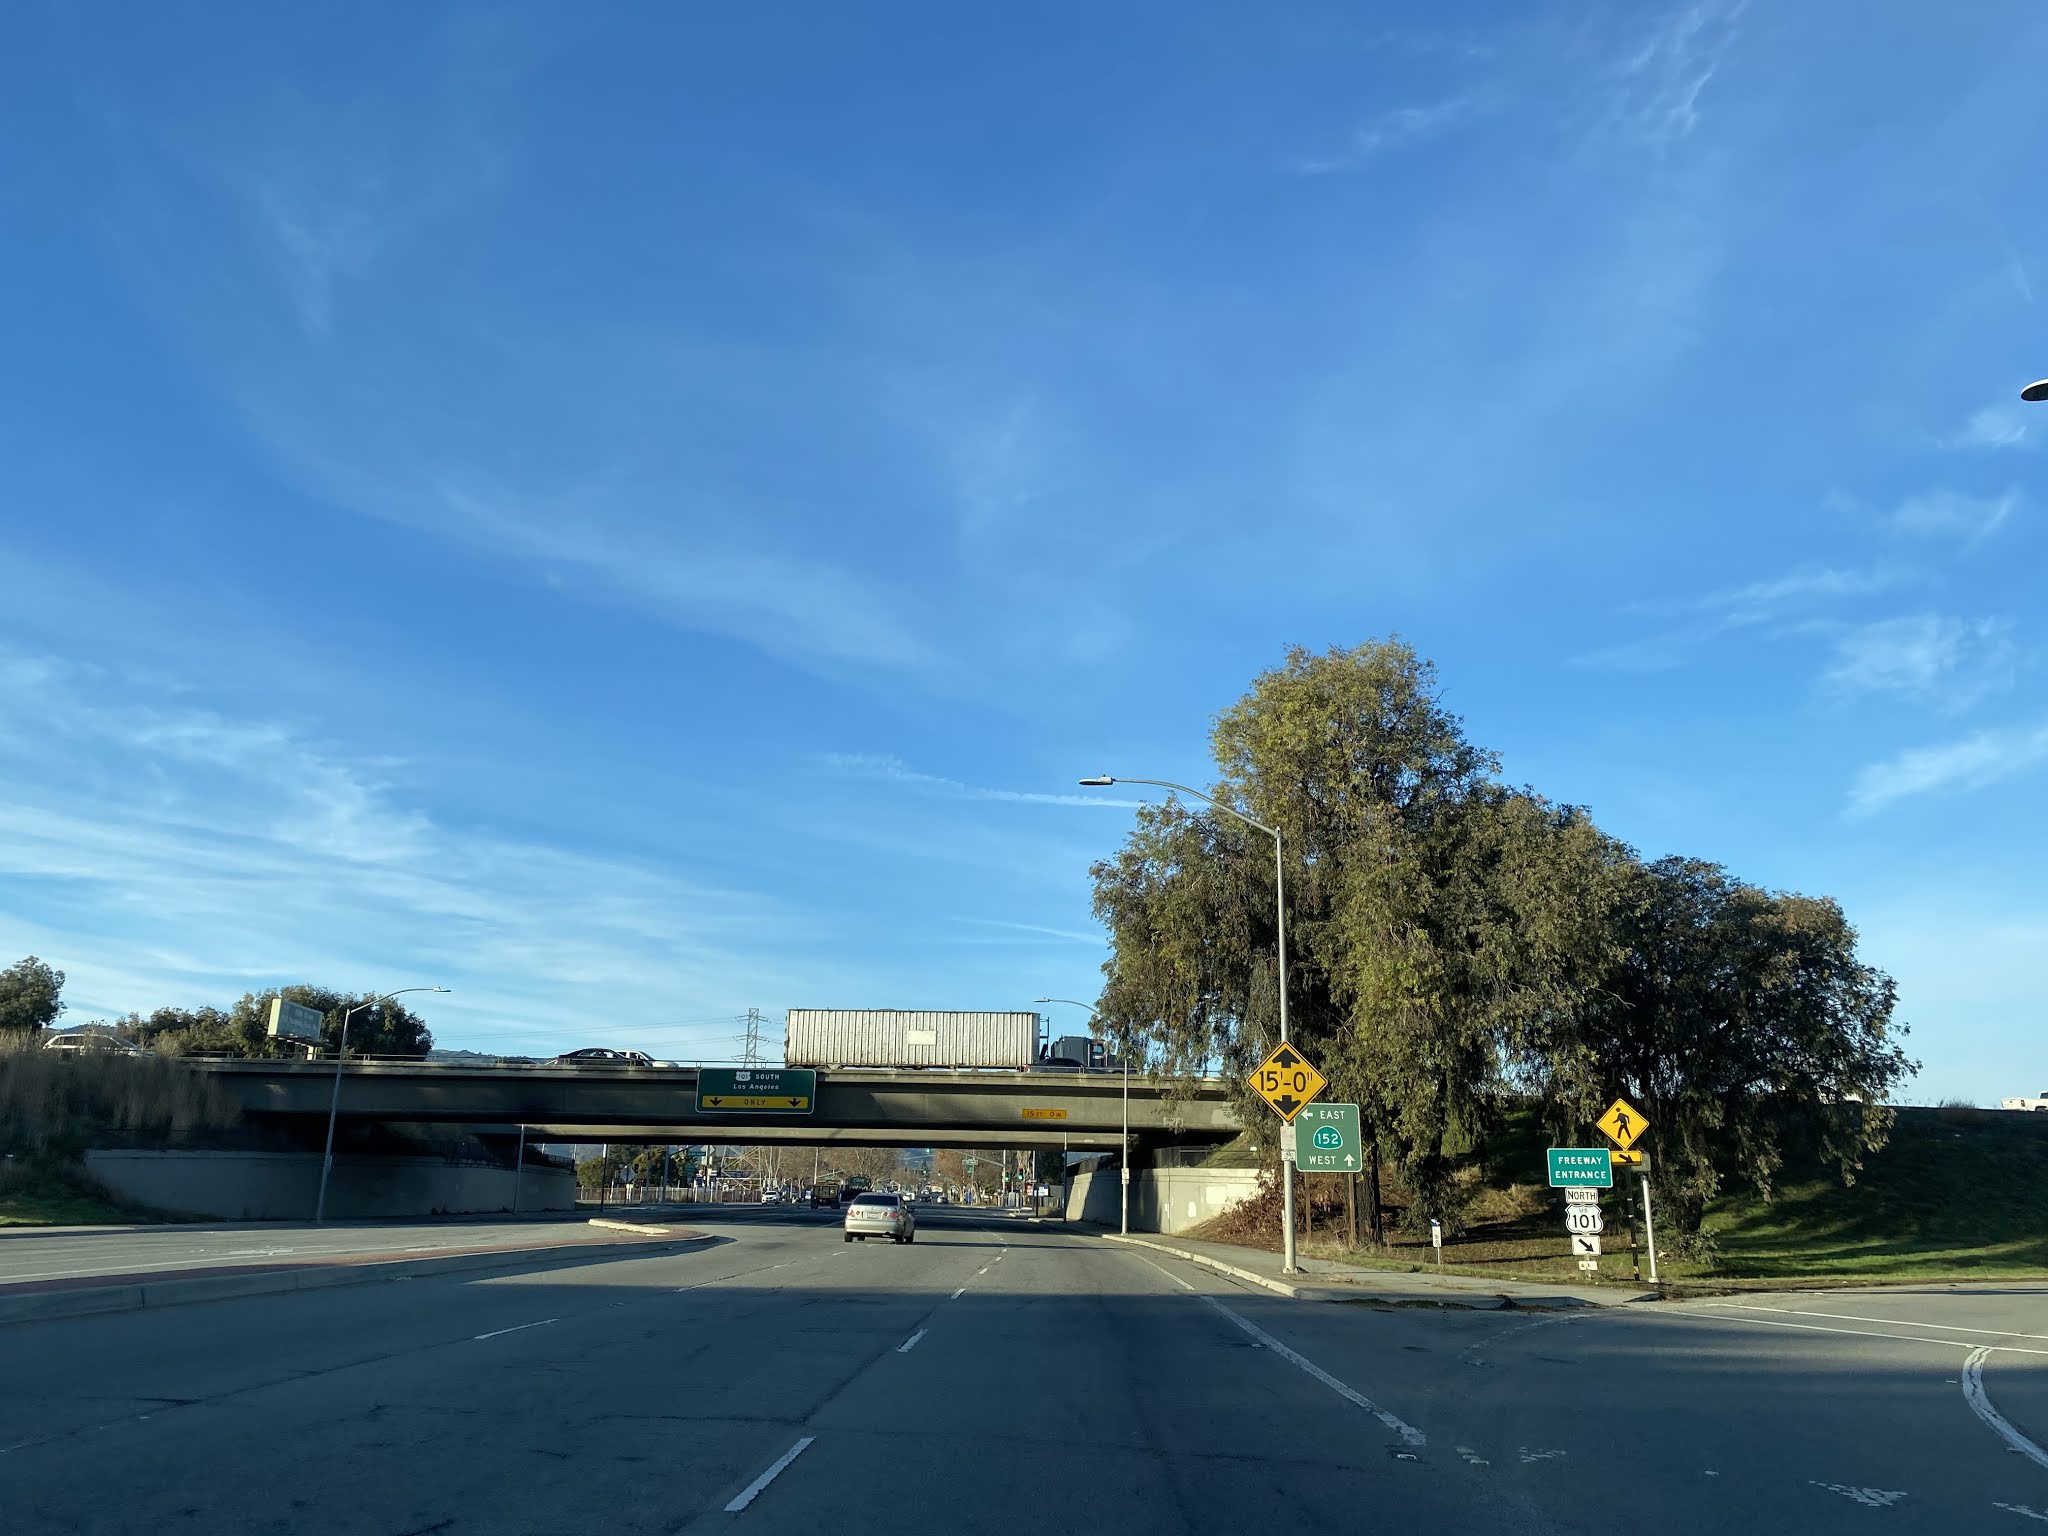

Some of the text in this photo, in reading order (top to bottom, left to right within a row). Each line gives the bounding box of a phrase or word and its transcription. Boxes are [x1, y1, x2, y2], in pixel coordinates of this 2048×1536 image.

[749, 1083, 779, 1091] Angeles
[744, 1098, 766, 1106] ONLY
[1320, 1110, 1345, 1120] EAST
[1317, 1133, 1339, 1145] 152
[1309, 1155, 1336, 1165] WEST
[1557, 1156, 1603, 1165] FREEWAY
[1555, 1170, 1607, 1179] ENTRANCE
[1568, 1191, 1596, 1200] NORTH
[1572, 1214, 1596, 1229] 101
